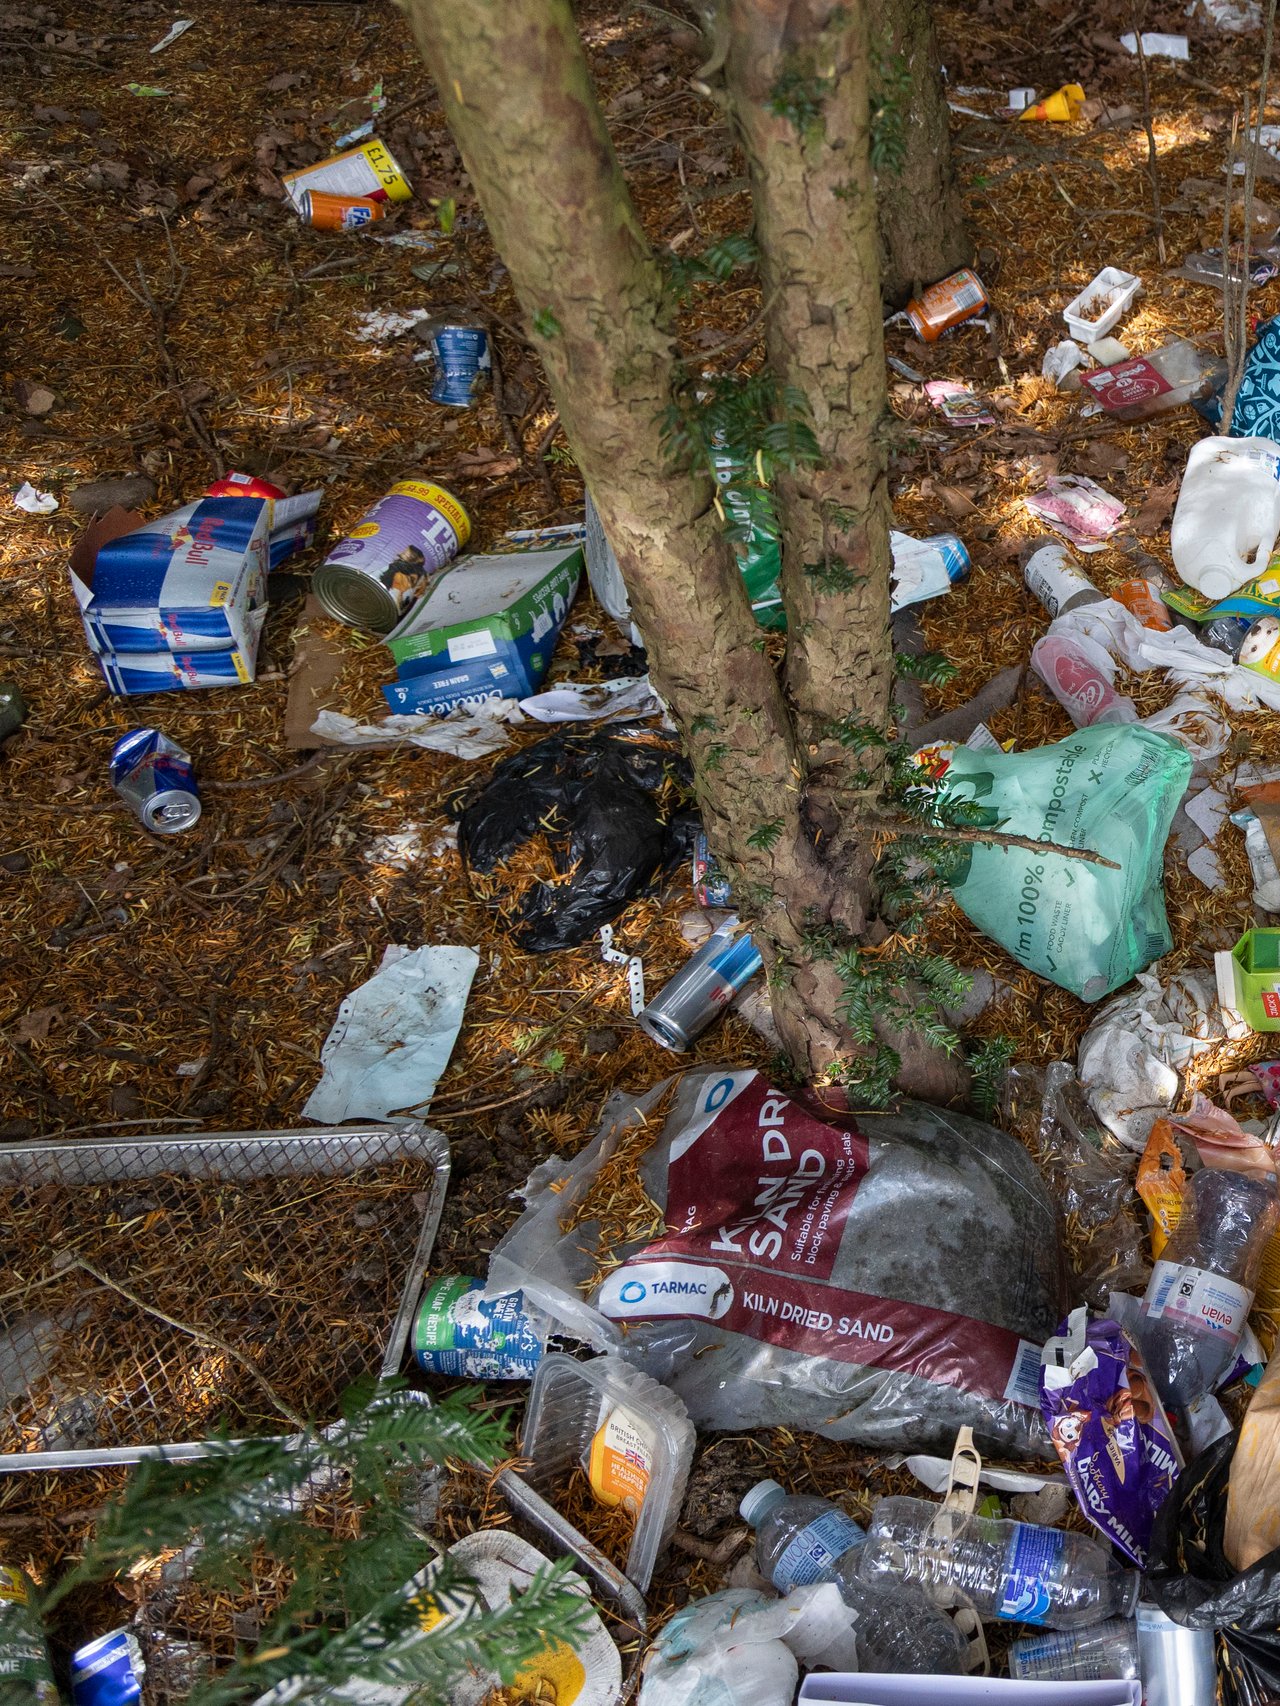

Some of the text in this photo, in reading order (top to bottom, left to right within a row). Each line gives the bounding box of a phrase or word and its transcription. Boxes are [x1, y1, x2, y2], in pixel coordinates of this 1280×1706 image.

[367, 147, 398, 185] £1.75
[434, 494, 462, 522] SPECIAL
[432, 674, 470, 690] GRAIN FREE
[397, 692, 408, 704] 6
[1074, 793, 1089, 825] COMPOST
[1017, 863, 1045, 926] 100%
[1047, 899, 1063, 951] FOOD WASTE
[1056, 902, 1073, 954] CADDY LINER
[1266, 993, 1280, 1017] JACK'S
[749, 1148, 826, 1261] SAND
[805, 1228, 824, 1265] block
[819, 1188, 840, 1231] paving
[841, 1131, 852, 1157] slab
[792, 1213, 813, 1262] Suitable
[808, 1193, 821, 1213] for
[431, 1292, 448, 1312] LOAF
[651, 1281, 707, 1295] TARMAC
[504, 1297, 519, 1322] GRAIN
[742, 1291, 895, 1343] KILN DRIED SAND
[1201, 1303, 1233, 1326] evian
[426, 1313, 438, 1346] RECIPE
[610, 1423, 635, 1441] BRITISH
[616, 1434, 637, 1449] BREAST
[611, 1462, 644, 1487] HEALTHIER
[618, 1472, 644, 1492] HAPPIER
[1089, 1451, 1110, 1500] Cadbury
[1077, 1456, 1149, 1565] DAIRY MILK
